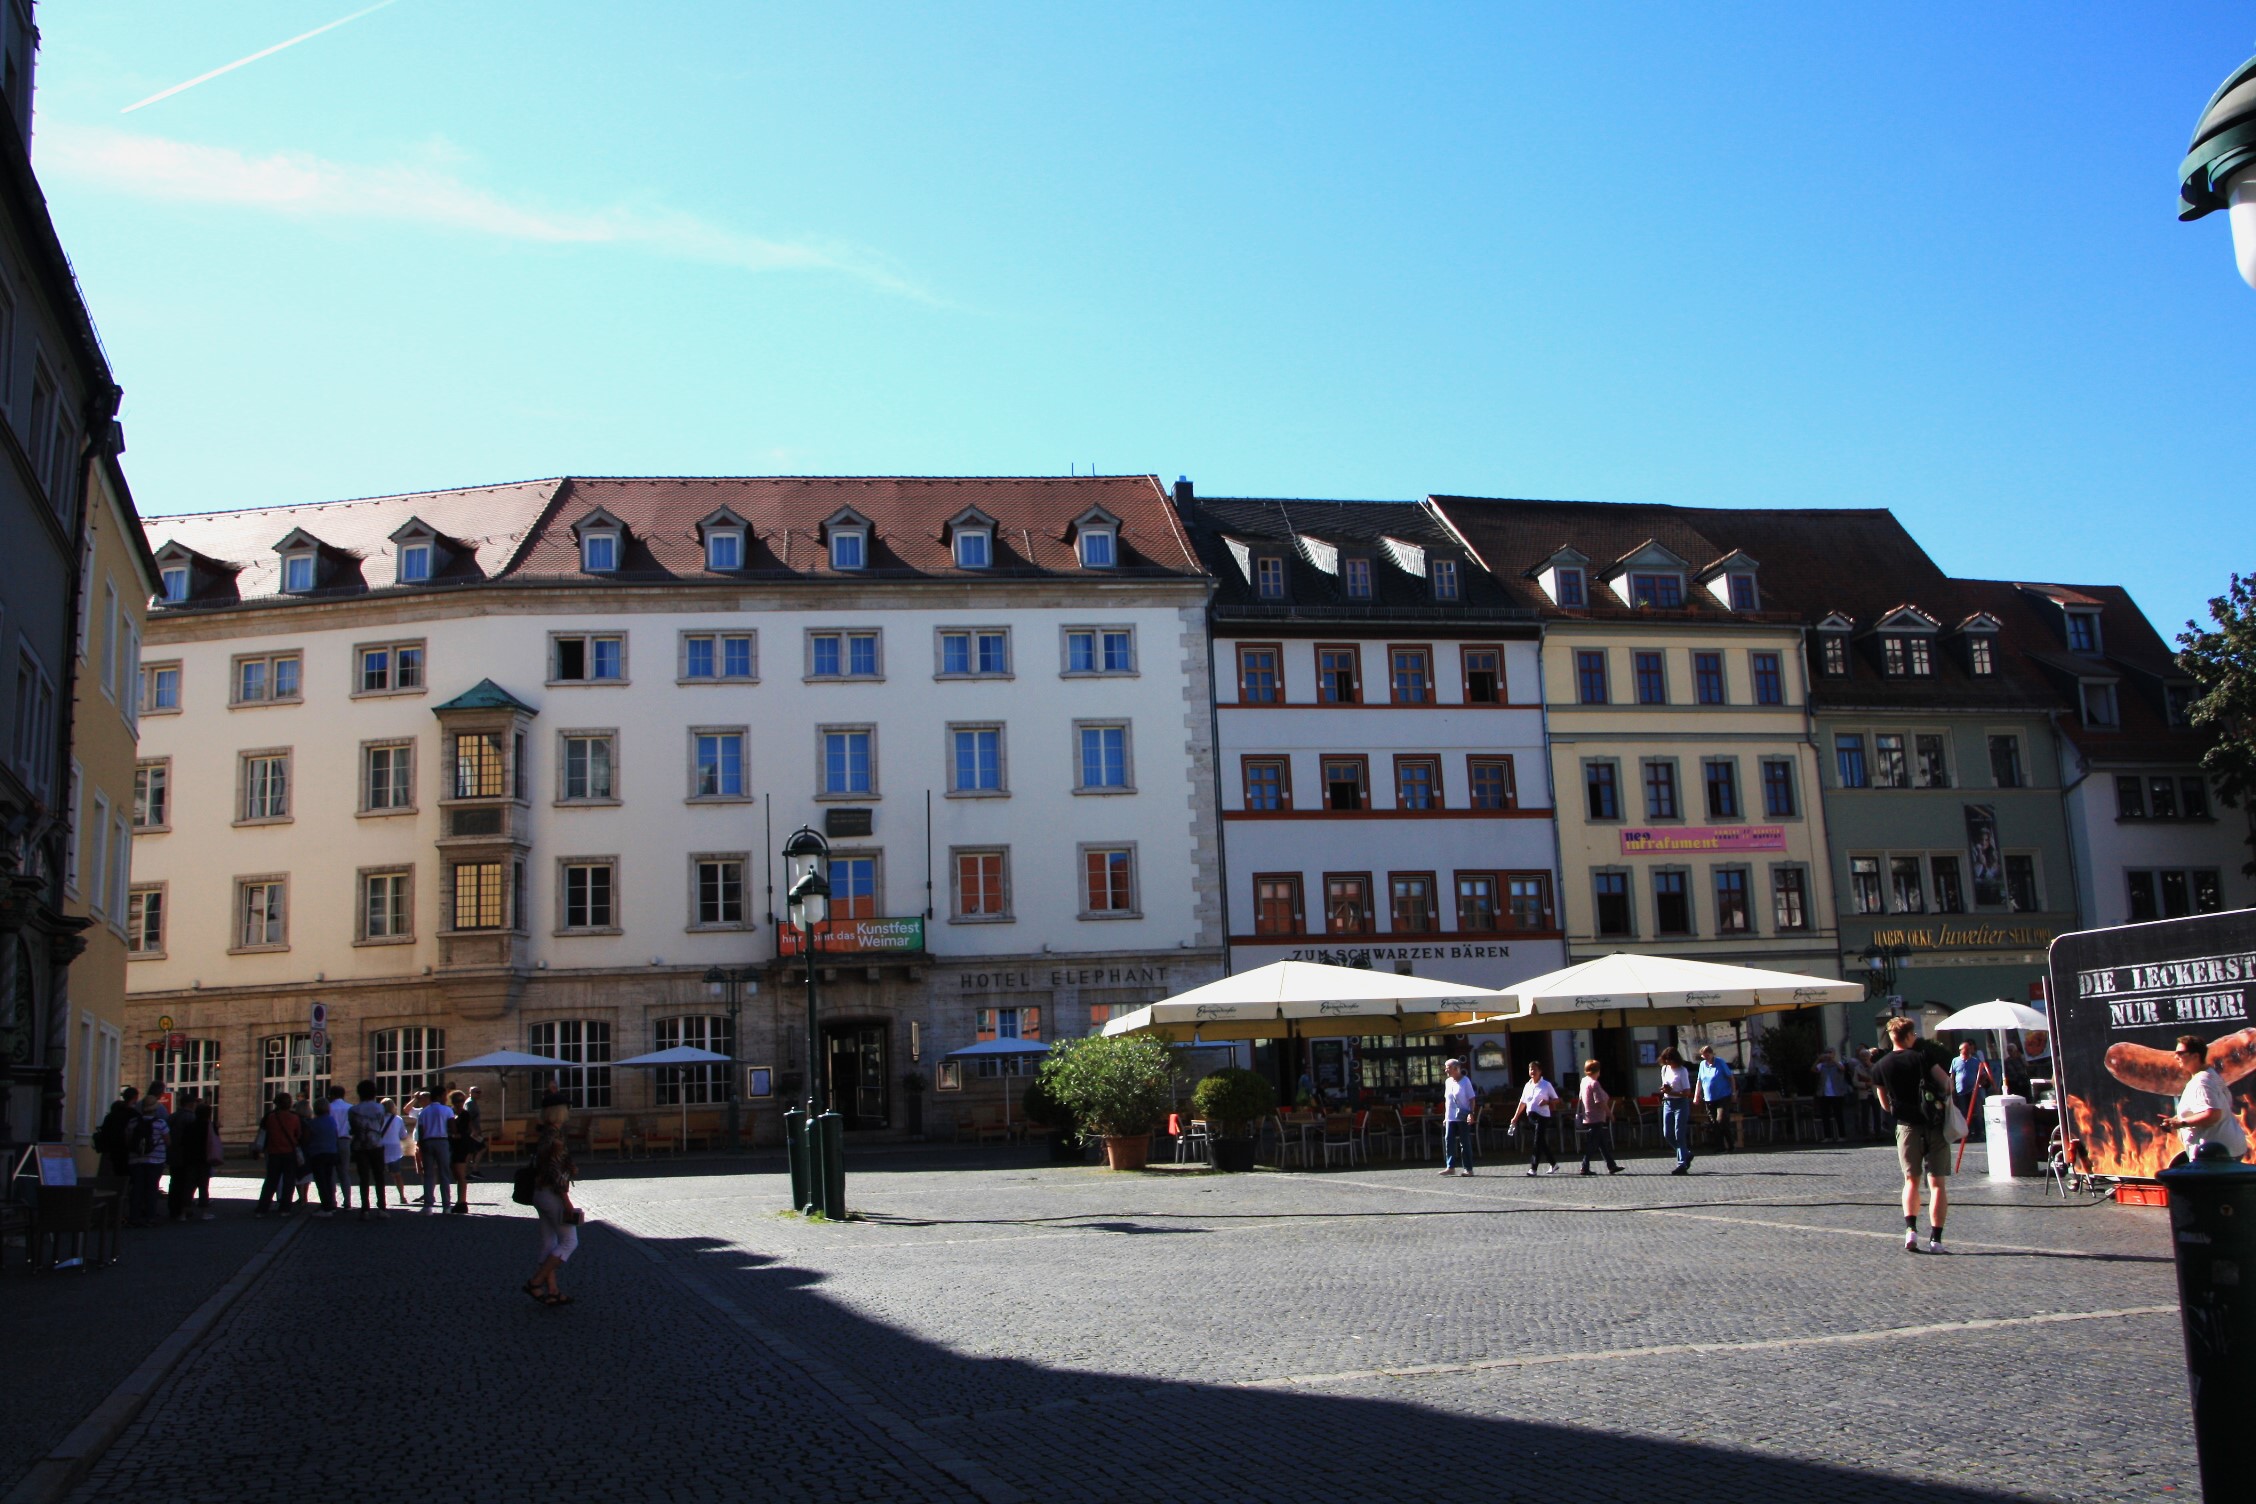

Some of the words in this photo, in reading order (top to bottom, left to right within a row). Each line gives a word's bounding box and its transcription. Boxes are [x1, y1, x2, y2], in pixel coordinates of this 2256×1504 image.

[837, 930, 855, 940] das
[857, 921, 920, 935] Kunstfest
[1933, 923, 2006, 948] Juwelier
[858, 935, 910, 948] Weimar
[1292, 949, 1329, 961] ZUM
[1336, 947, 1445, 960] SCHWARZEN
[1451, 944, 1510, 959] BÄREN
[961, 973, 1030, 988] HOTEL
[1051, 967, 1167, 985] ELEPHANT
[2078, 971, 2116, 995] DIE
[2109, 1001, 2160, 1026] NUR
[2175, 993, 2246, 1021] HIER!
